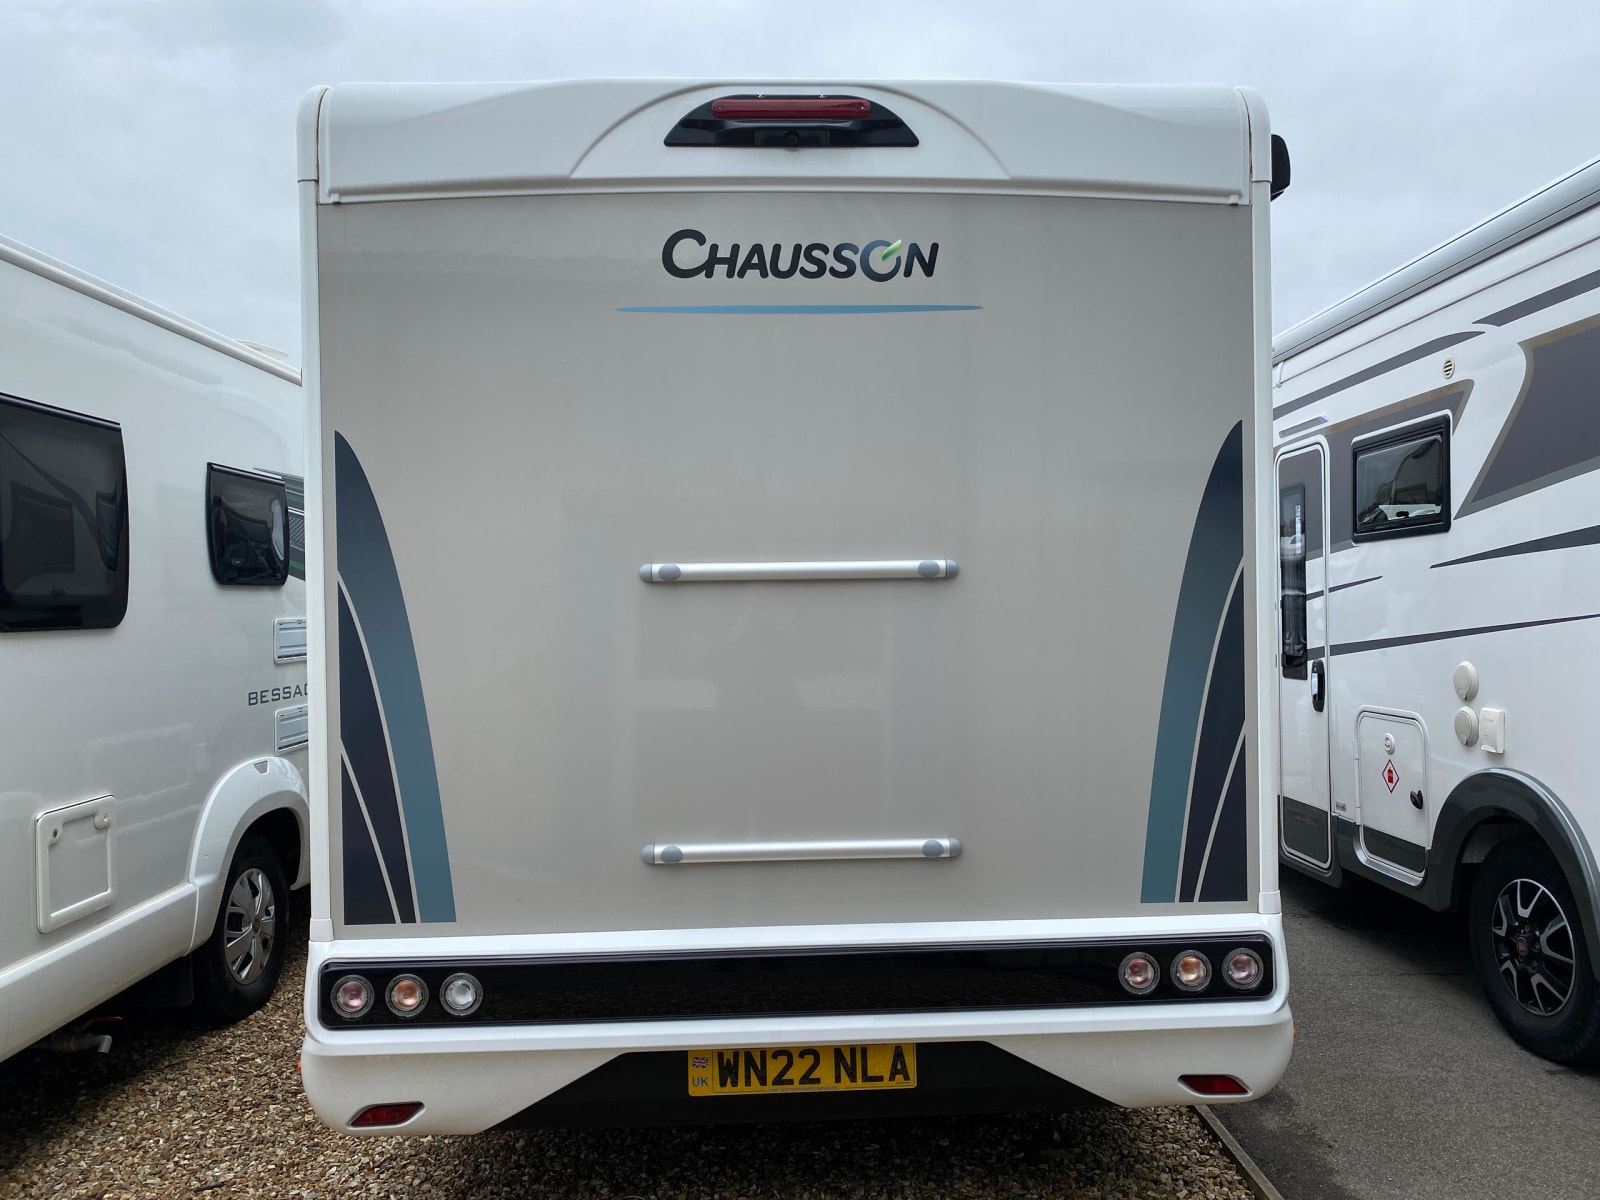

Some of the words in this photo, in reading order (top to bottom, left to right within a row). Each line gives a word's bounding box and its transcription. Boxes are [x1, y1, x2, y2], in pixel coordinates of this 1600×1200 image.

[661, 228, 939, 282] CHAUSSON
[692, 1077, 708, 1086] UK
[717, 1050, 821, 1087] WN22
[834, 1045, 911, 1083] NLA
